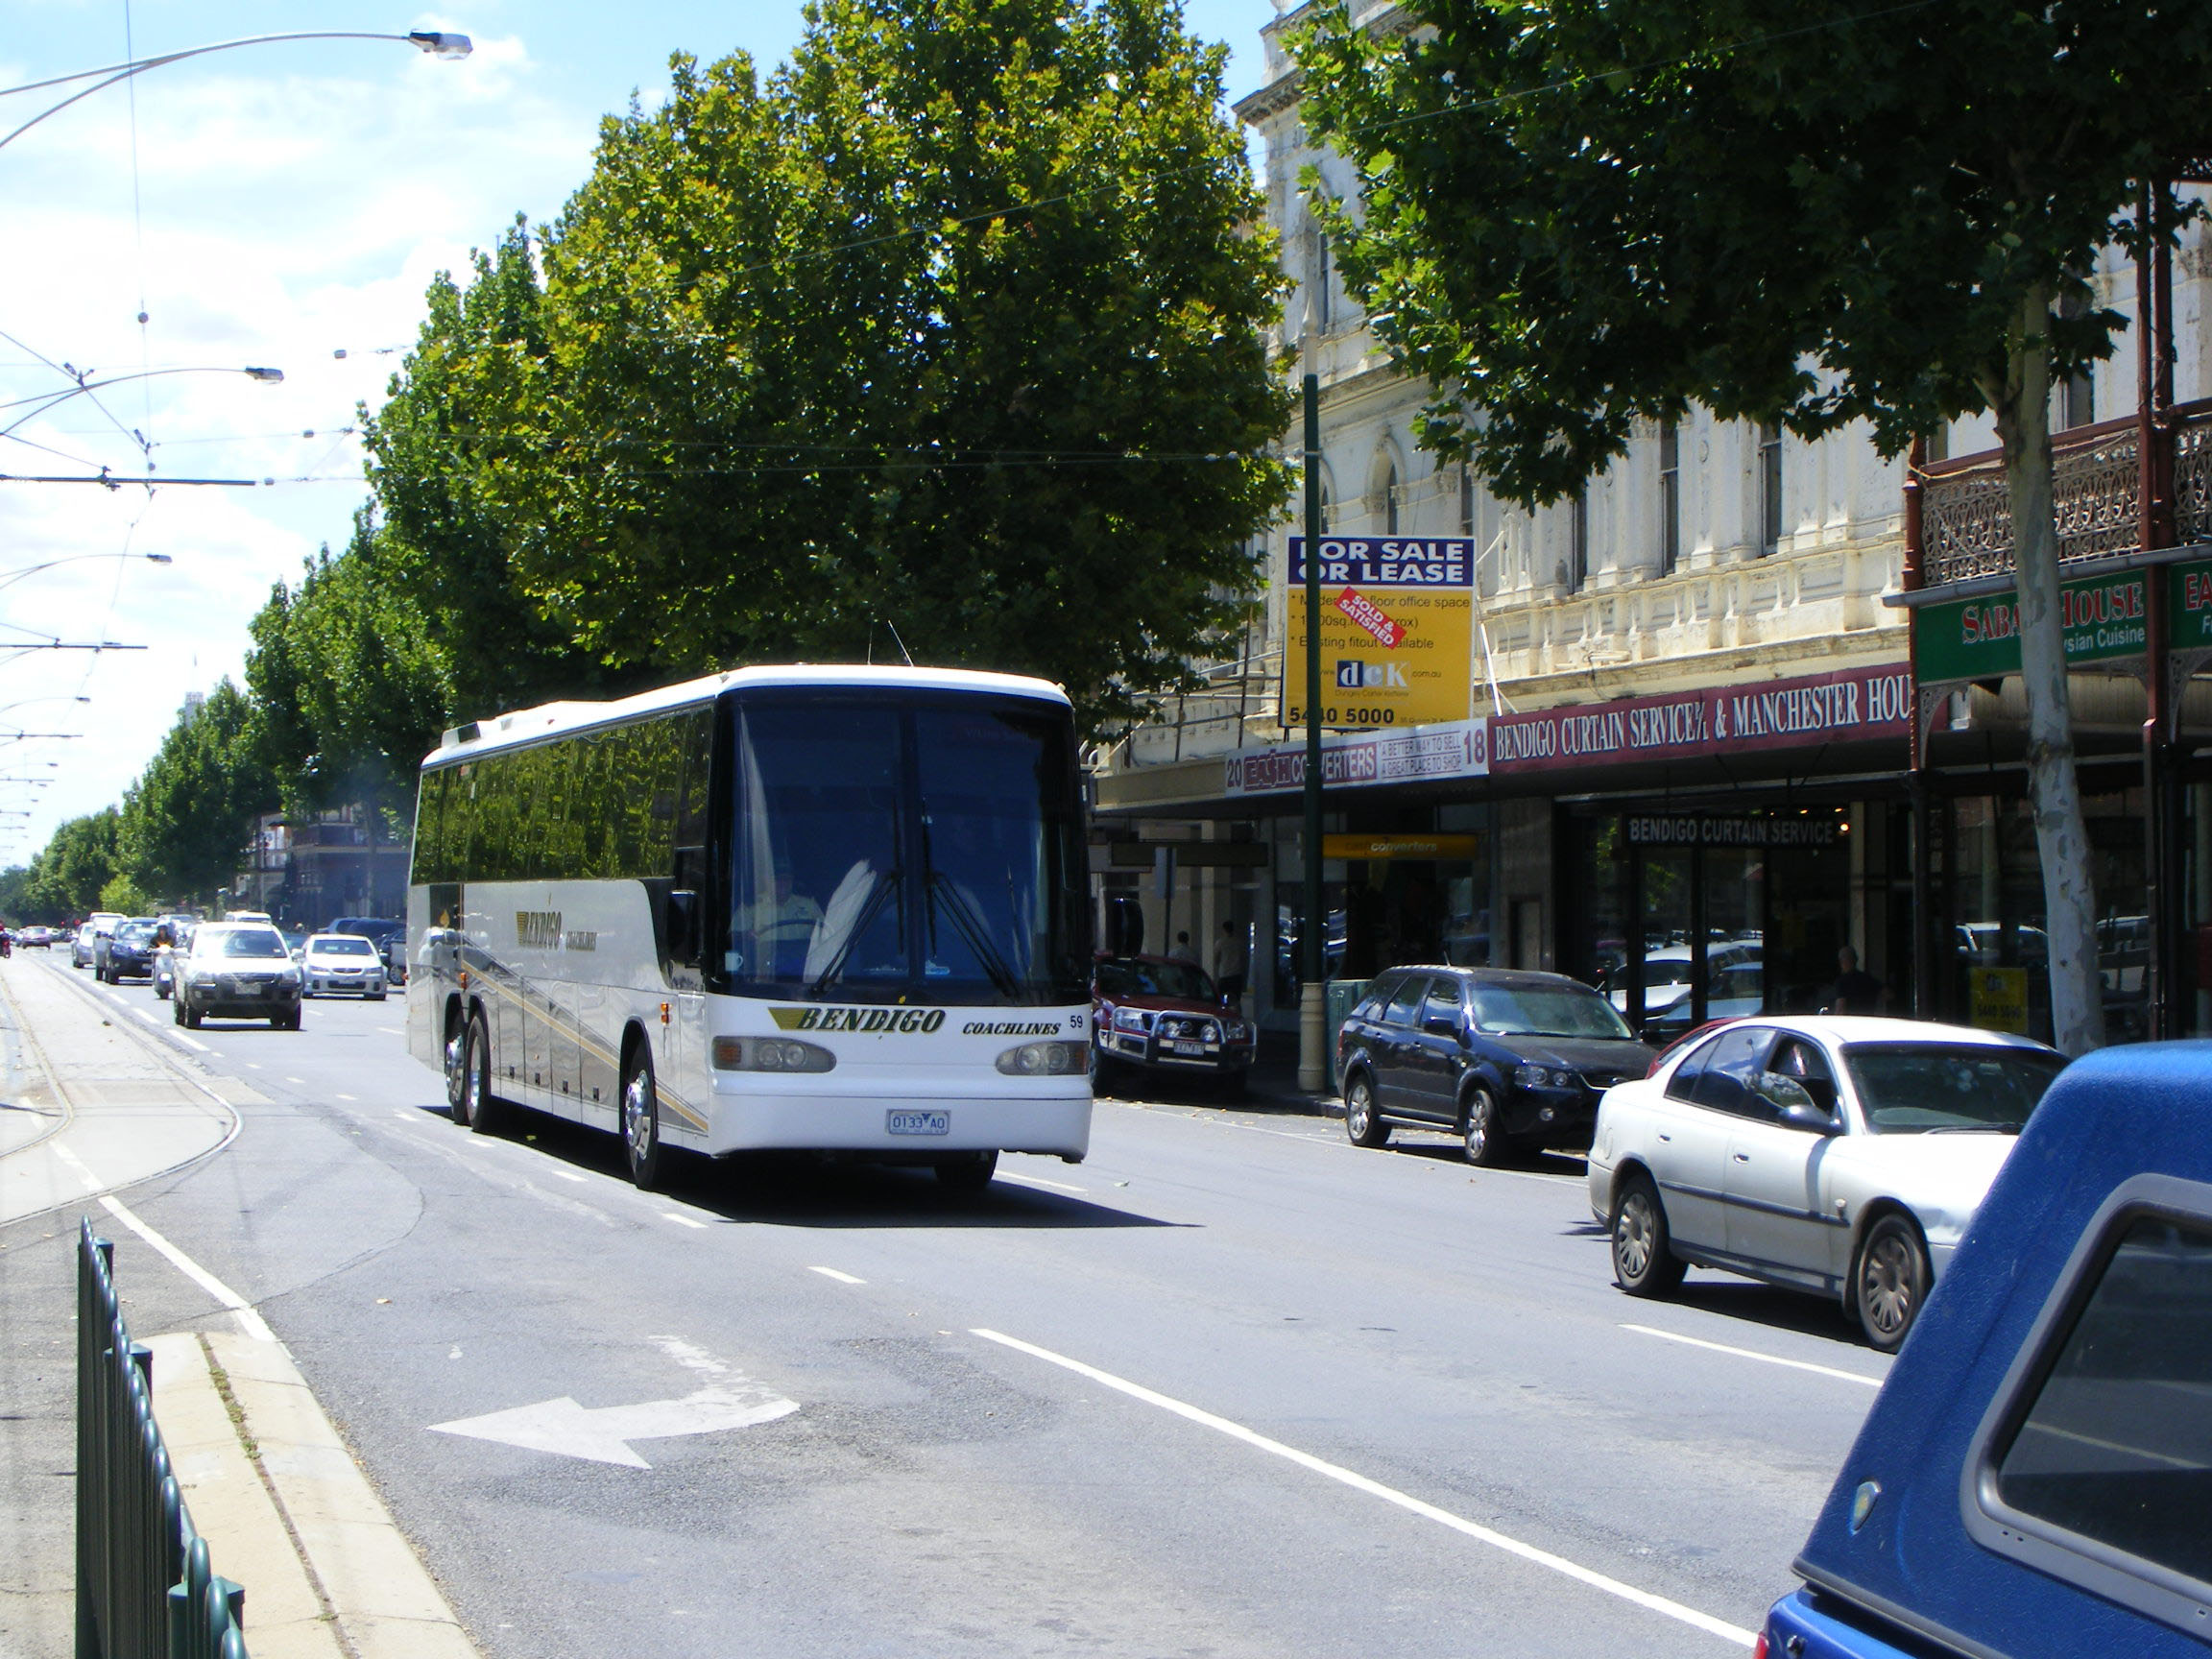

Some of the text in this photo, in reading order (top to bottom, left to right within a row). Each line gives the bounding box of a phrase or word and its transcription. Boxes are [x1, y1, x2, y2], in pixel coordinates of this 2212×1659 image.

[1381, 542, 1464, 561] SALE
[1298, 563, 1464, 582] OR LEASE
[1399, 595, 1431, 607] office
[1434, 598, 1470, 611] space
[1339, 599, 1394, 645] SATISFIED
[1352, 595, 1393, 633] SOLD &
[1961, 605, 2022, 644] SABA
[1299, 636, 1433, 649] Esting fitout aailable
[2097, 626, 2146, 647] Cuisine
[1346, 708, 1394, 723] 5000
[1495, 719, 1557, 761] BENDIGO
[1560, 711, 1625, 756] CURTAIN
[1629, 703, 1695, 748] SERVICE
[1715, 698, 1727, 739] &
[1733, 681, 1861, 738] MANCHESTER
[1866, 674, 1911, 722] HOU
[1388, 740, 1414, 757] BETTER
[1432, 736, 1442, 751] TO
[1444, 735, 1460, 750] SELL
[1464, 729, 1486, 764] 18
[1227, 758, 1242, 787] 20
[1291, 746, 1374, 782] COERTERS
[1388, 759, 1408, 775] GREAT
[1409, 757, 1431, 772] PLACE
[1432, 757, 1441, 770] TO
[1443, 755, 1461, 769] SHOP
[1629, 817, 1833, 844] BENDIGO CURTAIN SERVICE
[1370, 842, 1438, 853] converters
[796, 1008, 946, 1033] BENDIGO
[962, 1022, 1062, 1036] COACHLINES
[1070, 1015, 1084, 1029] 59
[893, 1116, 923, 1129] 0133
